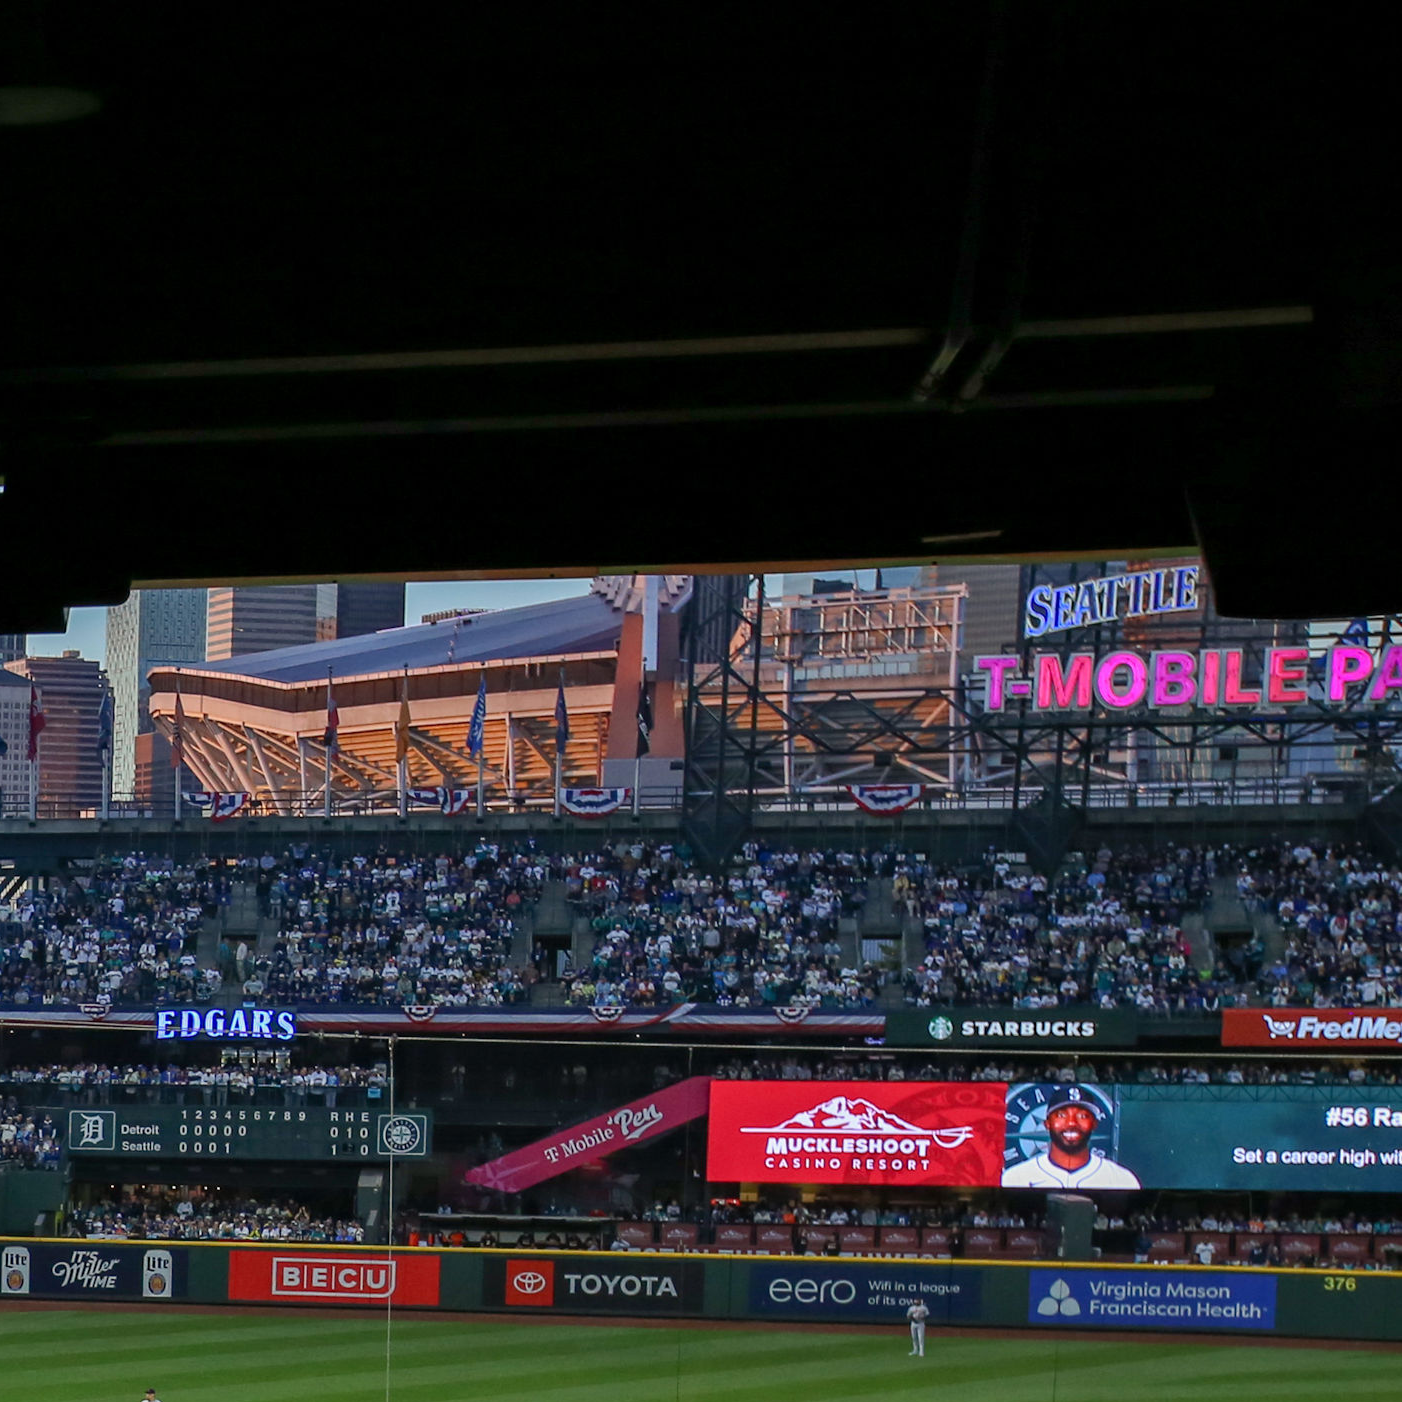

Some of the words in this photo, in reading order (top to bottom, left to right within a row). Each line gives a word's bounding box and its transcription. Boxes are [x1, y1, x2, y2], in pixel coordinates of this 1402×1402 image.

[1025, 565, 1199, 638] SEATTLE
[972, 646, 1311, 712] T-MOBILE
[156, 1009, 296, 1041] EDGAR'S
[961, 1020, 1095, 1038] STARBUCKS
[181, 1110, 187, 1121] 1
[194, 1110, 202, 1121] 2
[209, 1110, 217, 1121] 3
[223, 1110, 232, 1121] 4
[239, 1110, 246, 1121] 5
[253, 1111, 261, 1122] 6
[268, 1111, 276, 1122] 7
[283, 1111, 291, 1122] 8
[298, 1111, 306, 1122] 9
[330, 1112, 339, 1123] R
[345, 1112, 354, 1123] H
[361, 1112, 369, 1123] E
[1326, 1106, 1367, 1127] #56
[121, 1124, 159, 1136] Detroit
[179, 1125, 187, 1137] 0
[194, 1125, 202, 1137] 0
[209, 1125, 217, 1137] 0
[224, 1125, 232, 1137] 0
[238, 1125, 246, 1137] 0
[330, 1127, 339, 1139] 0
[360, 1127, 369, 1139] 0
[122, 1141, 161, 1152] Seattle
[179, 1142, 187, 1154] 0
[194, 1142, 202, 1154] 0
[209, 1142, 217, 1154] 0
[224, 1142, 231, 1154] 1
[331, 1144, 337, 1156] 1
[360, 1145, 369, 1157] 0
[558, 1127, 614, 1159] Mobile
[766, 1136, 931, 1157] MUCKLESHOOT
[765, 1157, 842, 1170] CASINO
[851, 1158, 931, 1171] RESORT
[1233, 1148, 1263, 1164] Set
[1265, 1152, 1277, 1164] a
[1281, 1152, 1336, 1165] career
[1339, 1148, 1376, 1168] high
[5, 1252, 28, 1268] Lite
[71, 1250, 98, 1264] IT'S
[147, 1257, 170, 1271] Lite
[52, 1258, 120, 1288] Miller
[82, 1275, 117, 1289] TIME
[564, 1273, 678, 1298] TOYOTA
[768, 1277, 857, 1304] eero
[868, 1280, 893, 1294] Wifi
[895, 1281, 906, 1294] in
[908, 1284, 917, 1295] a
[918, 1281, 961, 1298] league
[1089, 1281, 1161, 1302] Virginia
[1166, 1284, 1232, 1299] Mason
[1324, 1276, 1357, 1292] 376
[868, 1294, 880, 1307] of
[882, 1295, 895, 1307] its
[1089, 1300, 1192, 1318] Franciscan
[1195, 1302, 1264, 1320] Health
